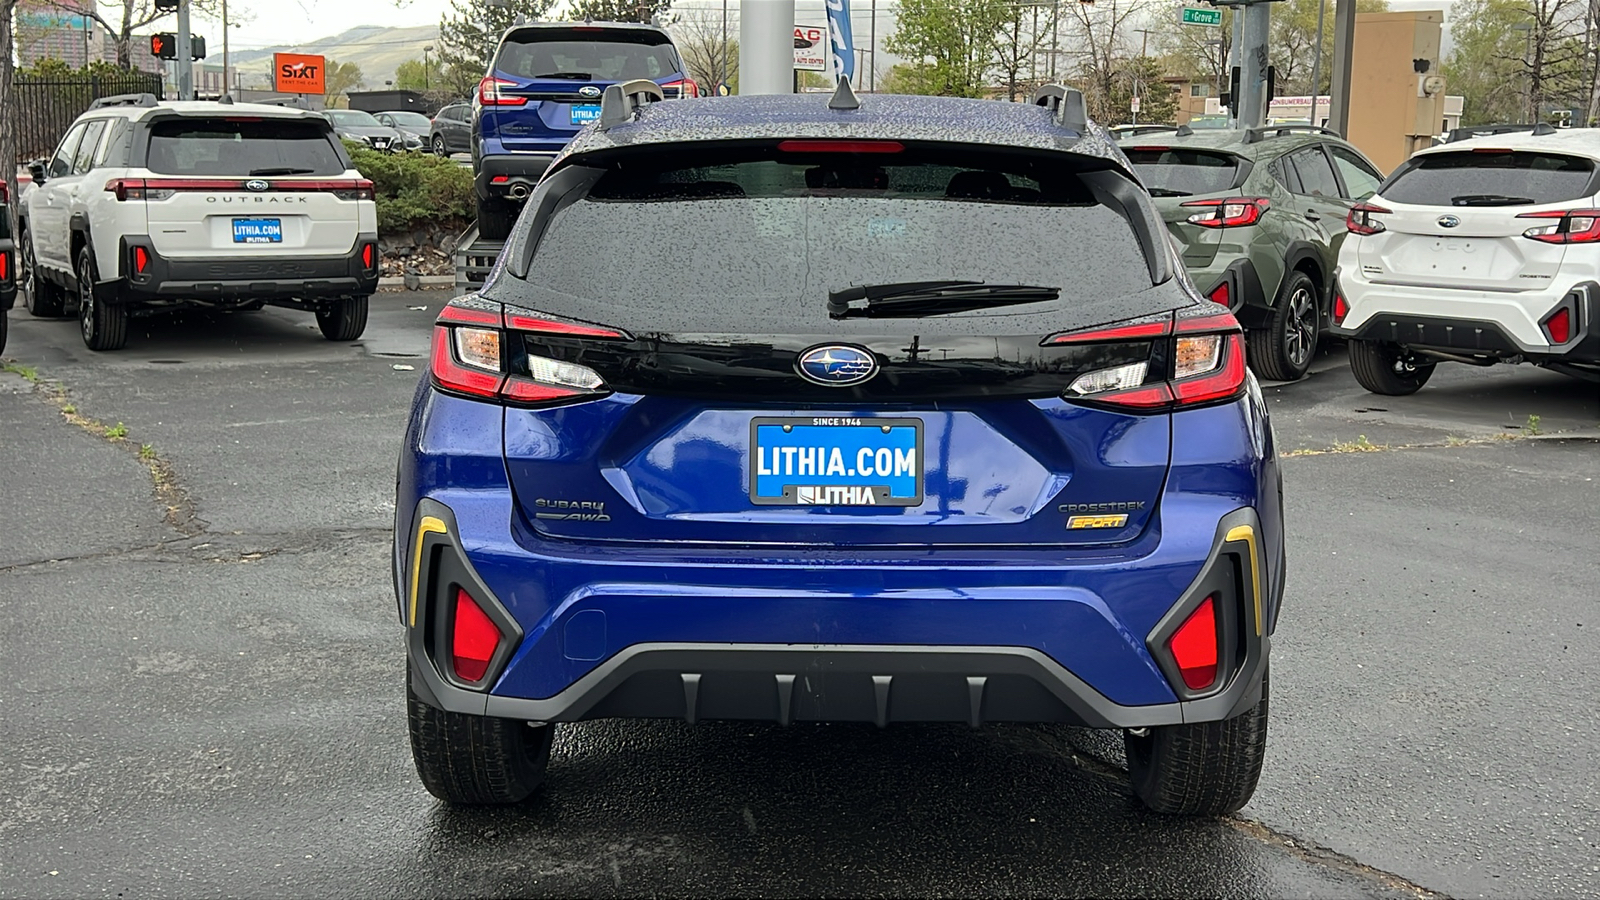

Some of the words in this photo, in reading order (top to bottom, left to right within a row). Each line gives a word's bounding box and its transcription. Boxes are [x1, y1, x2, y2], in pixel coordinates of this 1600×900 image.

[1194, 11, 1212, 22] Grove
[281, 63, 317, 79] SIXT
[233, 225, 281, 236] LITHIA.COM
[813, 417, 839, 426] SINCE
[841, 418, 862, 426] 1946
[757, 446, 916, 477] LITHIA.COM
[815, 486, 876, 505] LITHIA
[535, 498, 604, 510] SUBARU
[1058, 501, 1146, 513] CROSSTREK
[563, 513, 611, 522] AWD
[1071, 517, 1124, 529] SPORT
